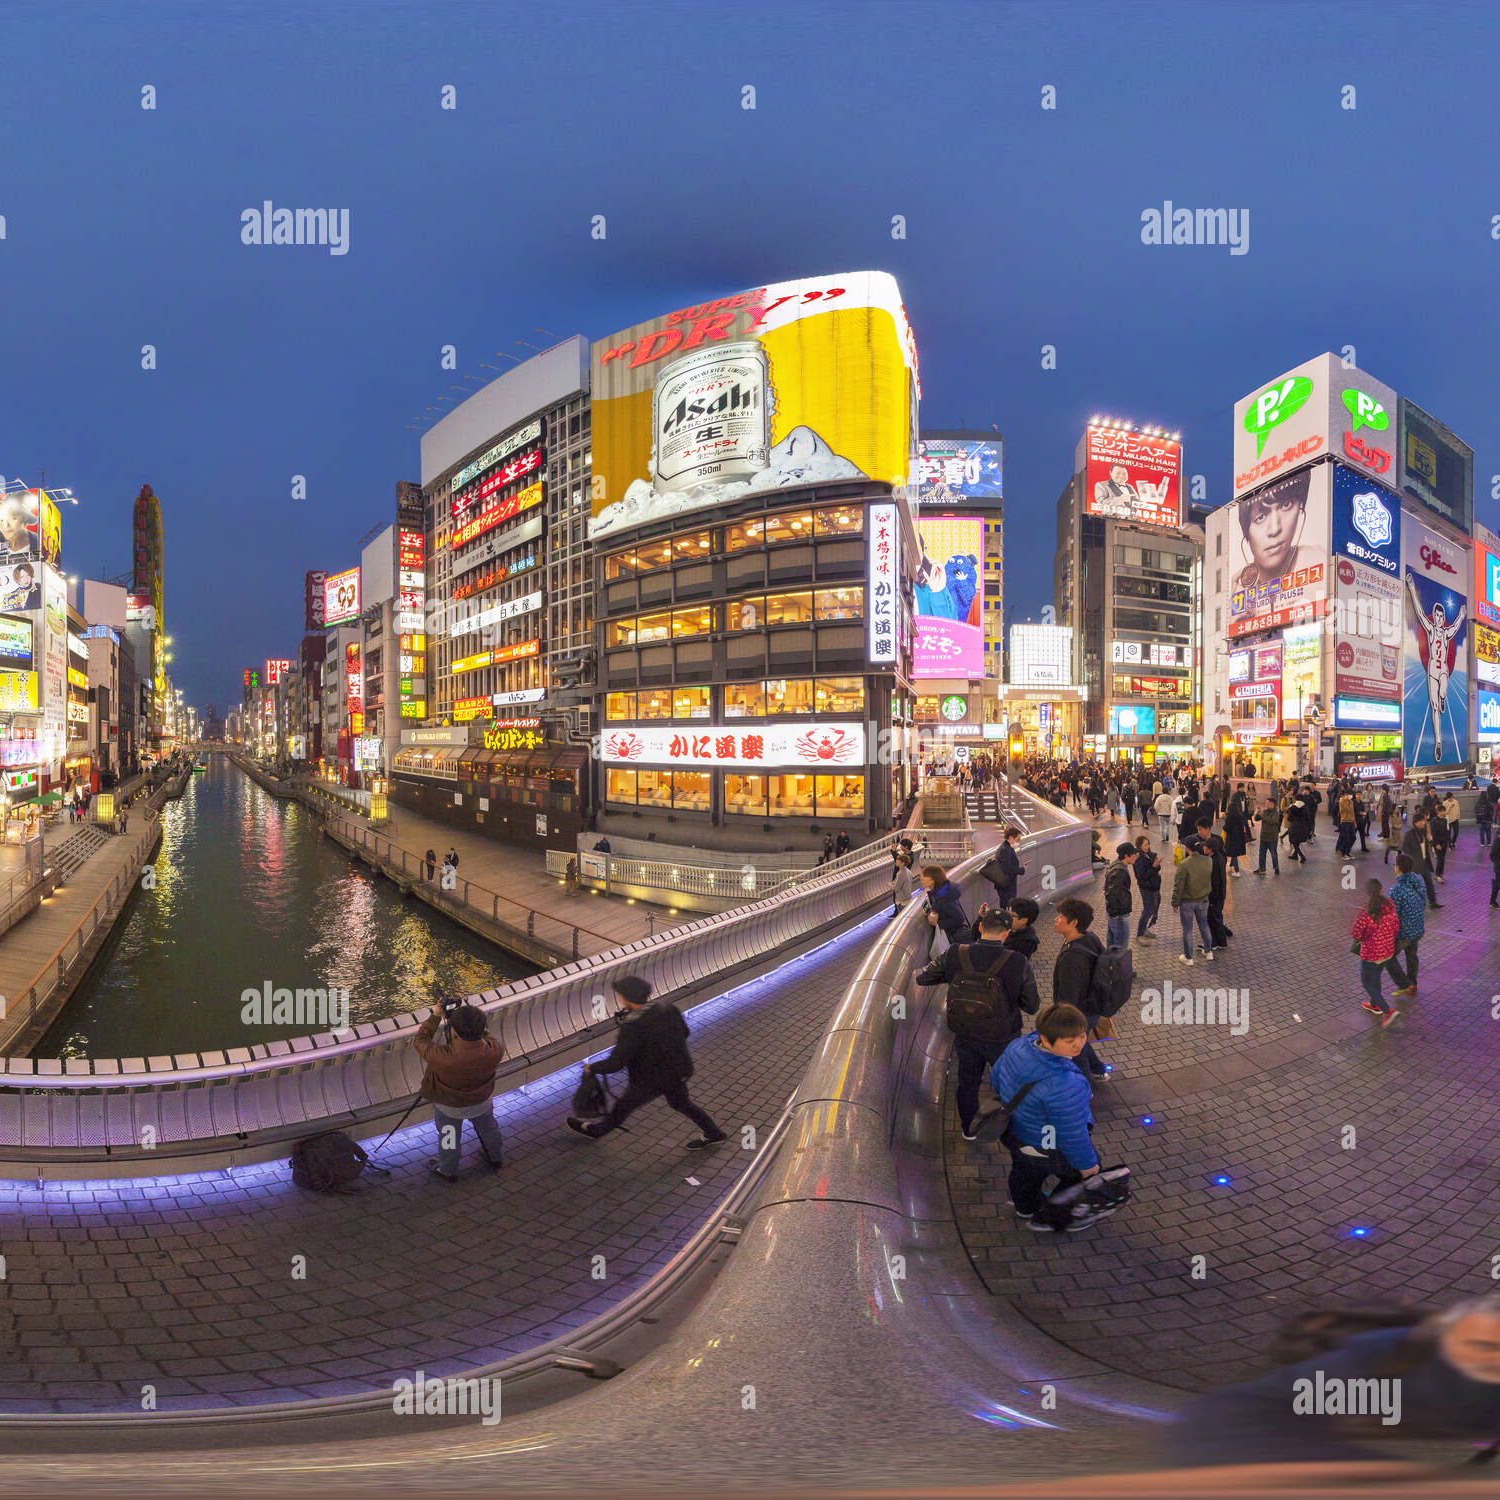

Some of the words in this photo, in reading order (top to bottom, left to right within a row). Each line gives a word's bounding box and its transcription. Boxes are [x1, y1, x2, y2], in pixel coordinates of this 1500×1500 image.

[665, 288, 767, 327] SUPER
[663, 383, 760, 434] Asahi
[696, 426, 724, 443] 生
[1091, 428, 1141, 442] スーパー
[683, 438, 739, 458] スーパードライ
[1091, 438, 1177, 458] ミリオンヘアー
[1091, 446, 1120, 456] SUPER
[1123, 451, 1154, 463] MILLION
[1156, 458, 1177, 467] HAIR
[1343, 430, 1392, 474] ピップ
[697, 464, 722, 477] 350ml
[1236, 435, 1323, 490] ピップエレキバン
[462, 499, 517, 542] 相席ダイニング
[876, 526, 890, 575] 本場の味
[1347, 541, 1397, 570] 雪印メグミルク
[1420, 544, 1458, 575] Glico
[1232, 564, 1323, 613] サタデープラス
[500, 598, 530, 619] 白木屋
[1237, 613, 1282, 634] 土曜あさ8時
[1241, 683, 1273, 696] LOTTERIA
[484, 728, 544, 750] びっくりドンキー
[938, 726, 980, 735] TSUTAYA
